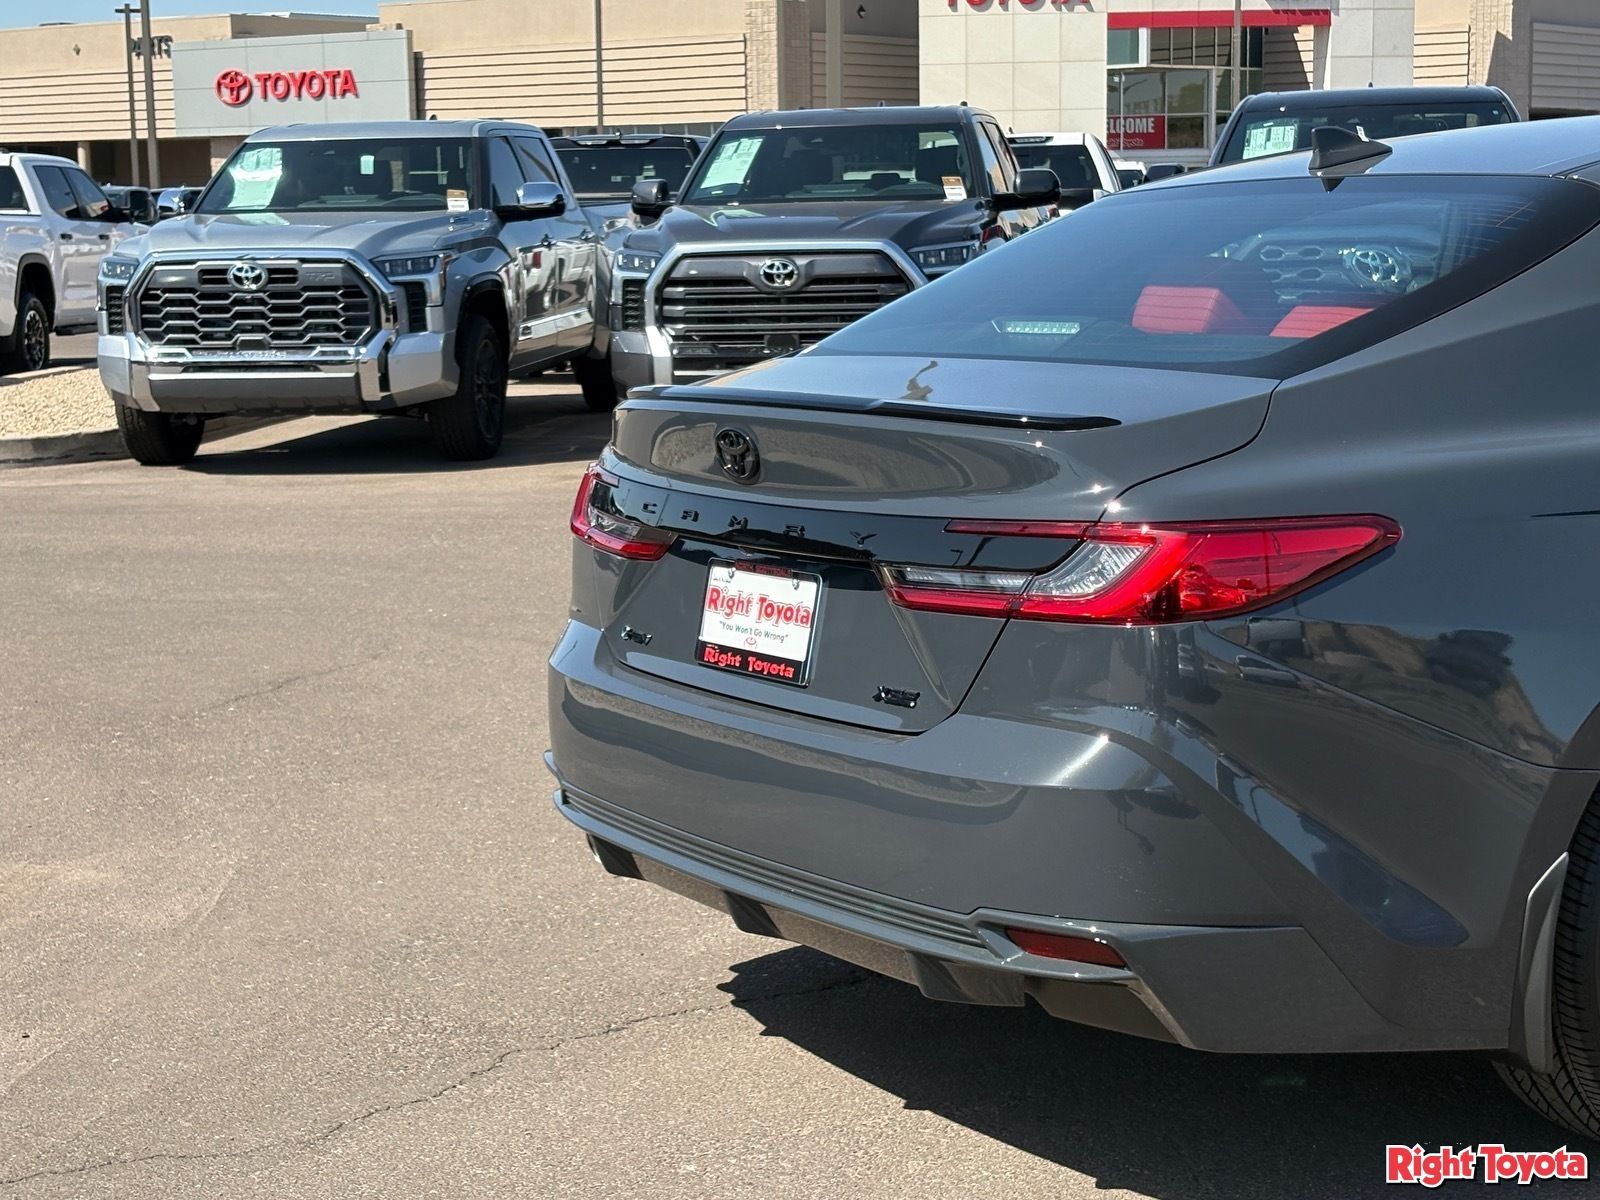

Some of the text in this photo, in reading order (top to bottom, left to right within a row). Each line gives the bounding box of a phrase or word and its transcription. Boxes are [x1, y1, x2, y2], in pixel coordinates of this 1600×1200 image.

[254, 69, 359, 100] TOYOTA
[1107, 118, 1155, 134] LCOME
[641, 502, 877, 545] CAMRY
[705, 585, 812, 628] Right Toyota
[753, 628, 763, 638] Go
[703, 645, 794, 678] Right Toyota
